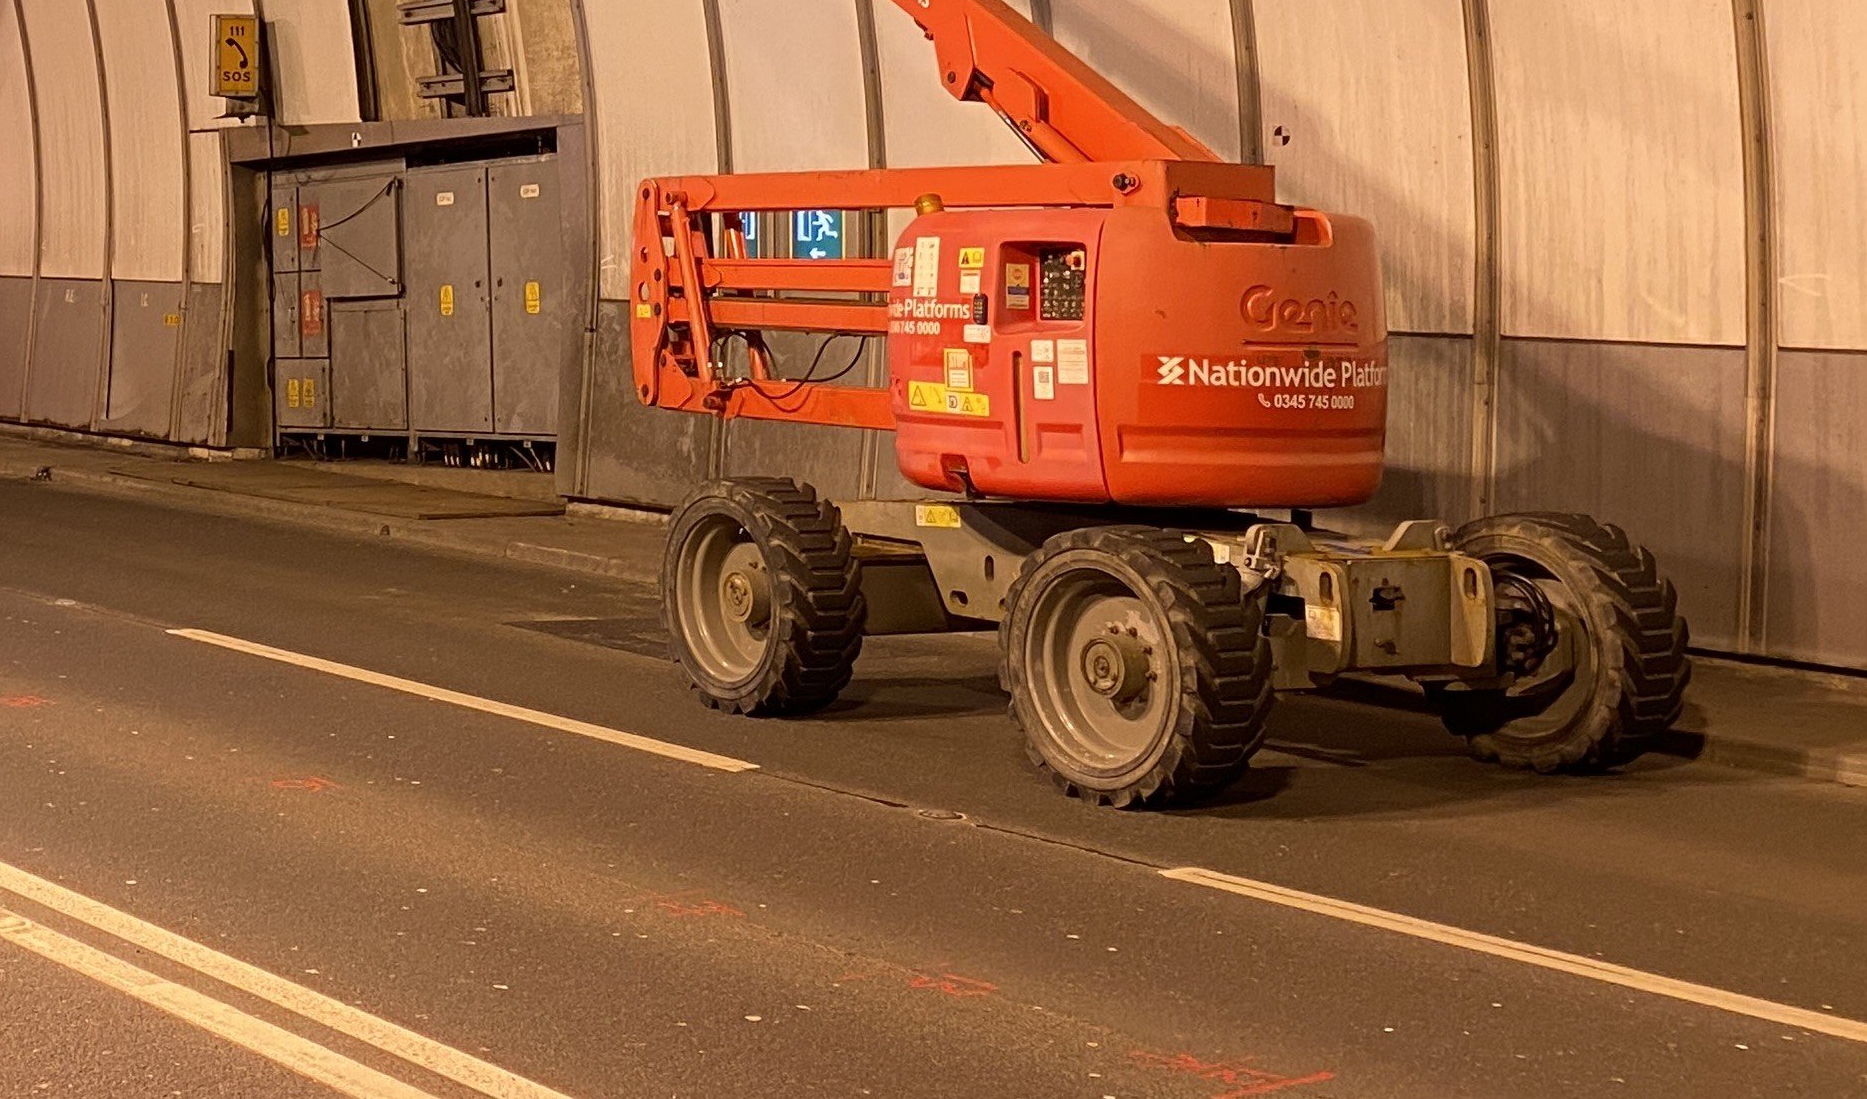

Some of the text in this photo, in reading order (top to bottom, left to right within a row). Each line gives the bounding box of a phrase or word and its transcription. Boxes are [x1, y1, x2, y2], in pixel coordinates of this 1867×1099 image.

[222, 71, 250, 82] SOS
[904, 298, 970, 320] Platforms
[1240, 284, 1358, 333] Genie
[916, 321, 941, 335] 0000
[1189, 359, 1386, 388] Nationwide Platfor
[1274, 393, 1354, 409] 0345 745 0000
